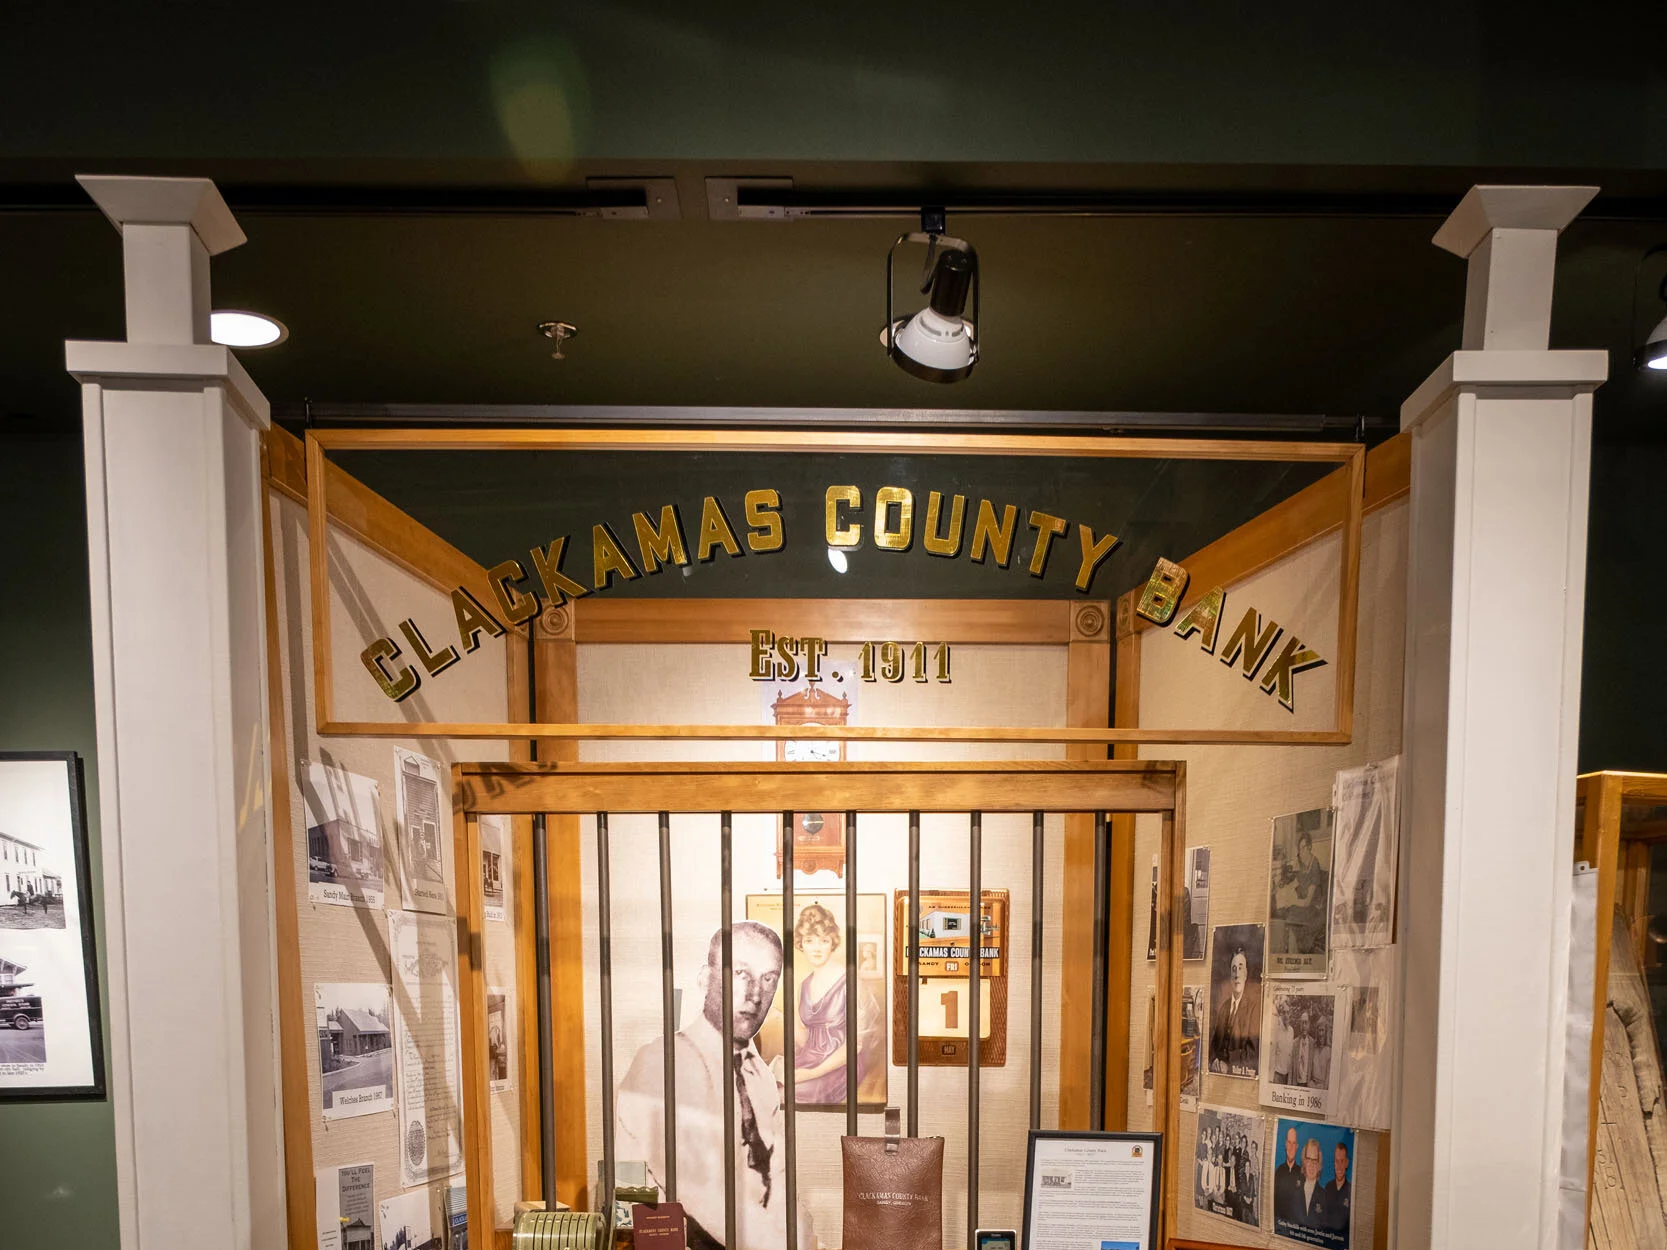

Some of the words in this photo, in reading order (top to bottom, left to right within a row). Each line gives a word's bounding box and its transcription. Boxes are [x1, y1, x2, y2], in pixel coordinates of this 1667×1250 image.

[359, 487, 787, 703] CLACKAMAS
[825, 485, 1123, 593] COUNTY
[1136, 556, 1329, 714] BANK
[857, 641, 952, 684] 1911
[951, 947, 969, 957] COUN
[980, 947, 999, 957] BANK
[946, 962, 958, 971] FRI
[940, 990, 958, 1029] 1
[1271, 1091, 1297, 1108] Banking
[1298, 1095, 1305, 1106] in
[858, 1192, 892, 1200] CLACKAMAS
[892, 1192, 913, 1200] COUNTY
